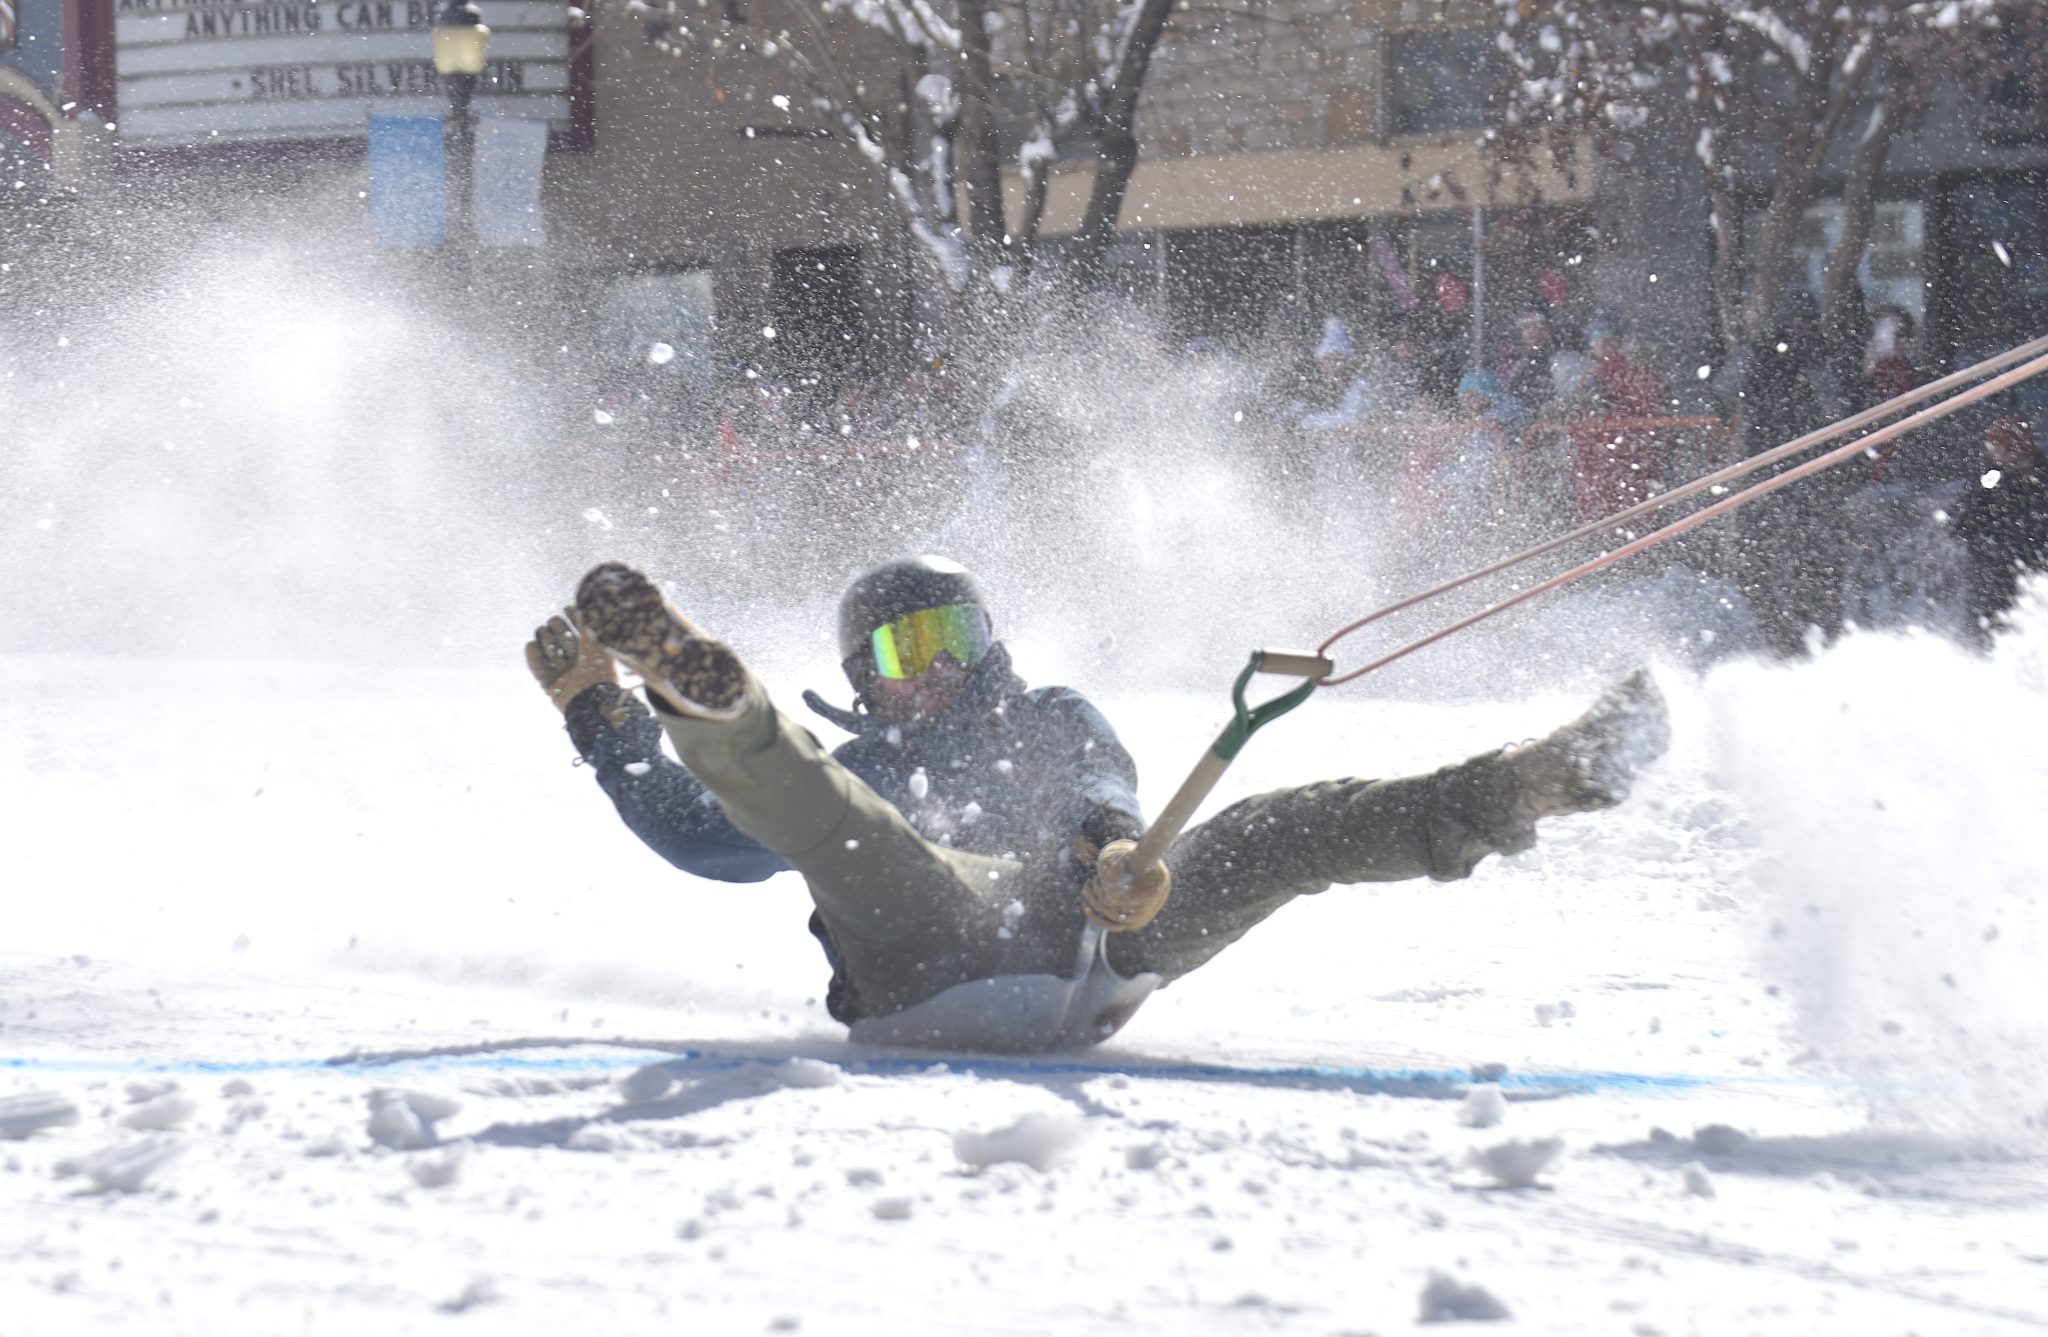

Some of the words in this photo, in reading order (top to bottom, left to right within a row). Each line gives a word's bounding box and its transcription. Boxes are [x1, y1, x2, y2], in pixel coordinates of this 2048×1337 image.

[184, 4, 321, 37] ANYTHING
[336, 3, 392, 29] CAN
[250, 67, 319, 97] SHEL
